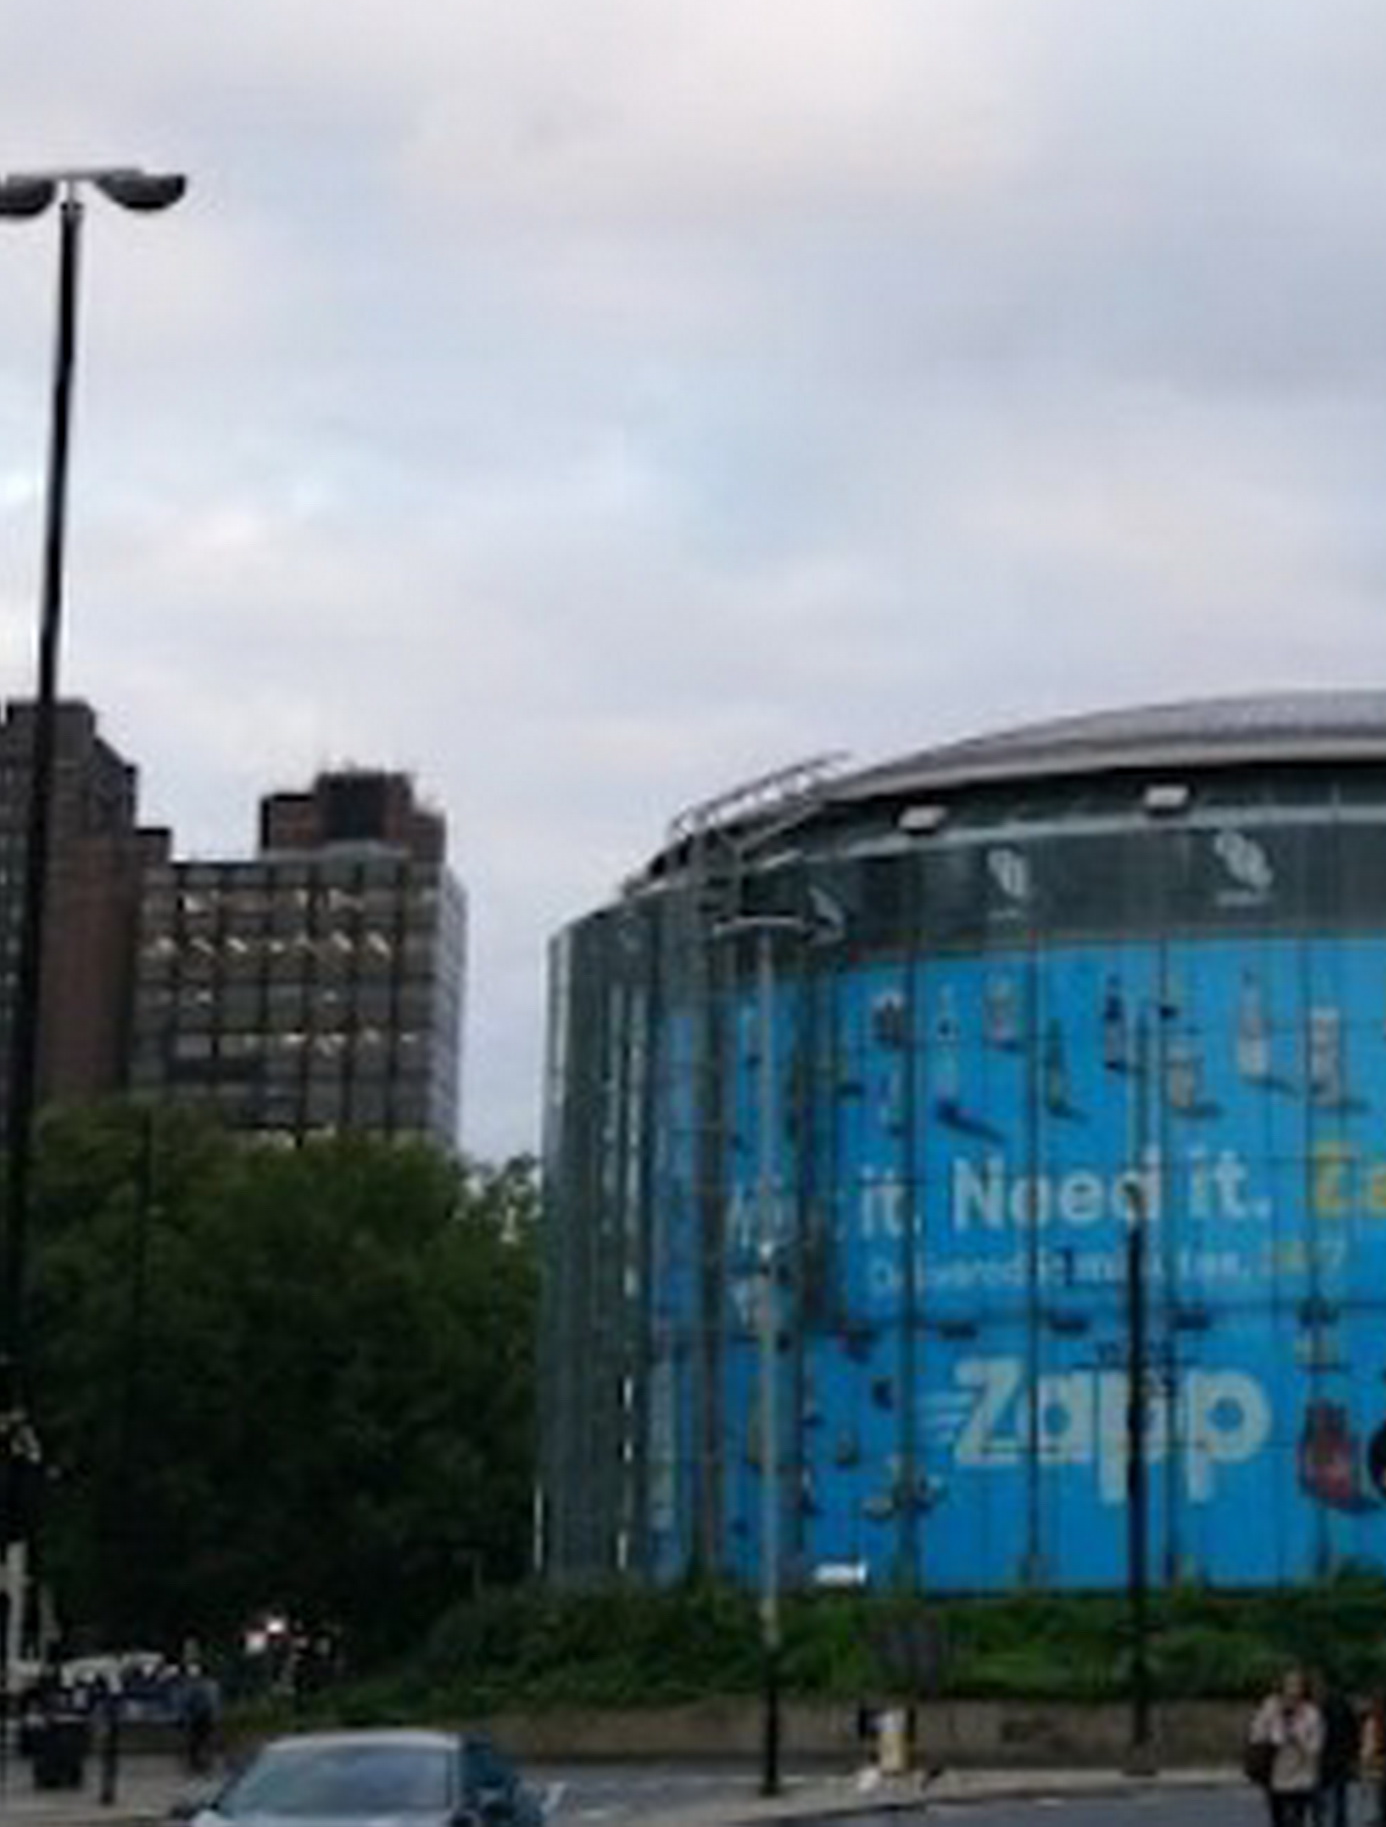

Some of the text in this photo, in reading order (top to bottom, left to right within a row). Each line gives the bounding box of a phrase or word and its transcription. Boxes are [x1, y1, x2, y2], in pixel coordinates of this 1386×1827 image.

[953, 1144, 1161, 1231] Need
[1188, 1147, 1270, 1219] it.
[953, 1358, 1272, 1505] Zapp
